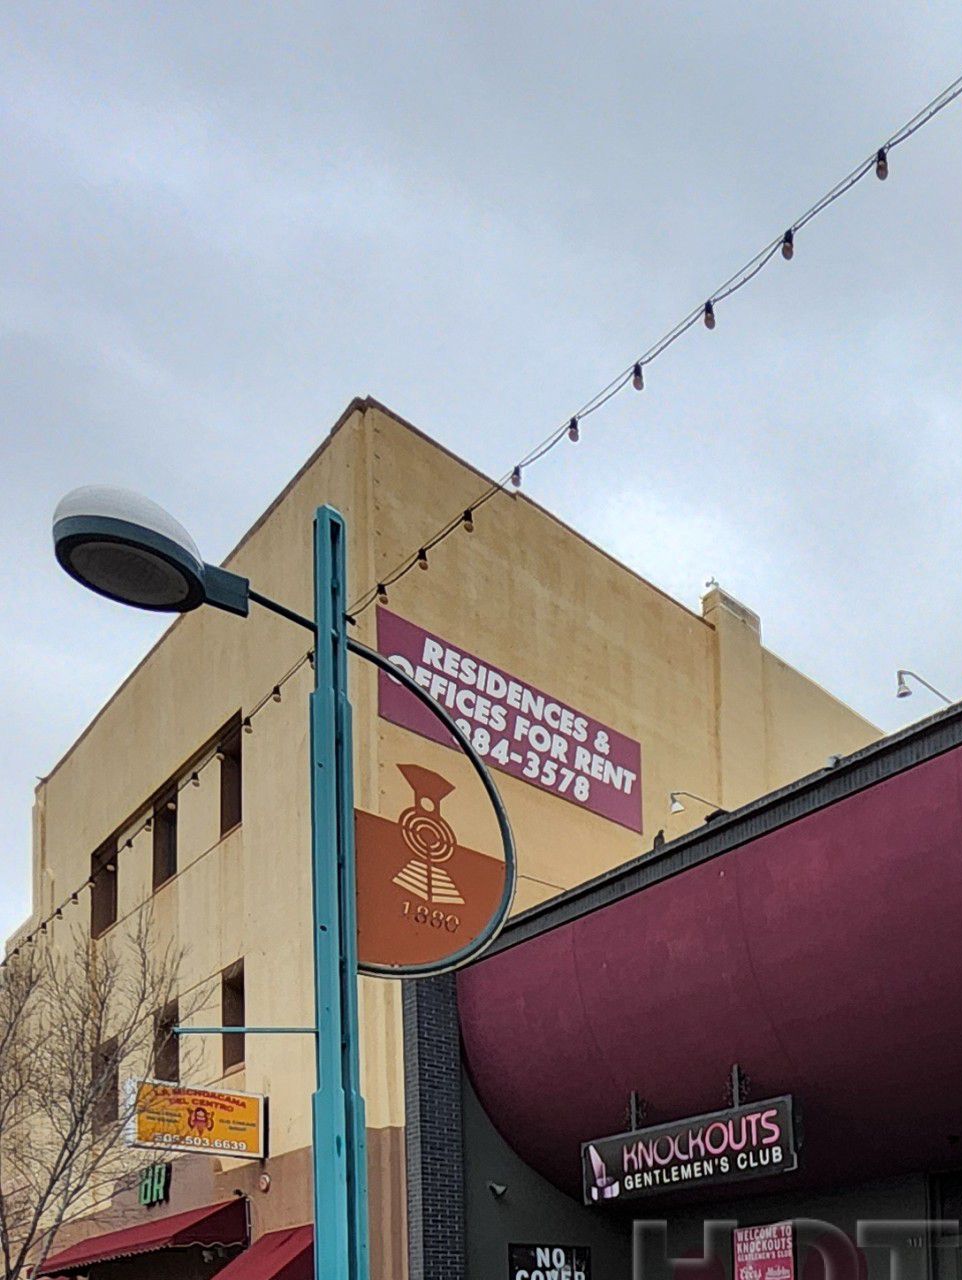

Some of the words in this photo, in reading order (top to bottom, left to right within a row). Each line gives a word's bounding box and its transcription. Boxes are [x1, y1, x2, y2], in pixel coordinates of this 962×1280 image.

[423, 637, 588, 742] RESIDENCES
[594, 730, 611, 755] &
[385, 655, 507, 731] OFFICES
[514, 715, 569, 763] FOR
[575, 746, 637, 794] RENT
[402, 901, 460, 934] 1880
[623, 1109, 781, 1172] KNOCKOUTS
[624, 1157, 730, 1190] GENTLEMEN'S
[736, 1146, 783, 1170] CLUB
[737, 1226, 779, 1242] WELCOME
[781, 1225, 792, 1237] TO
[737, 1237, 793, 1254] KNOCKOUTS
[536, 1247, 565, 1269] NO
